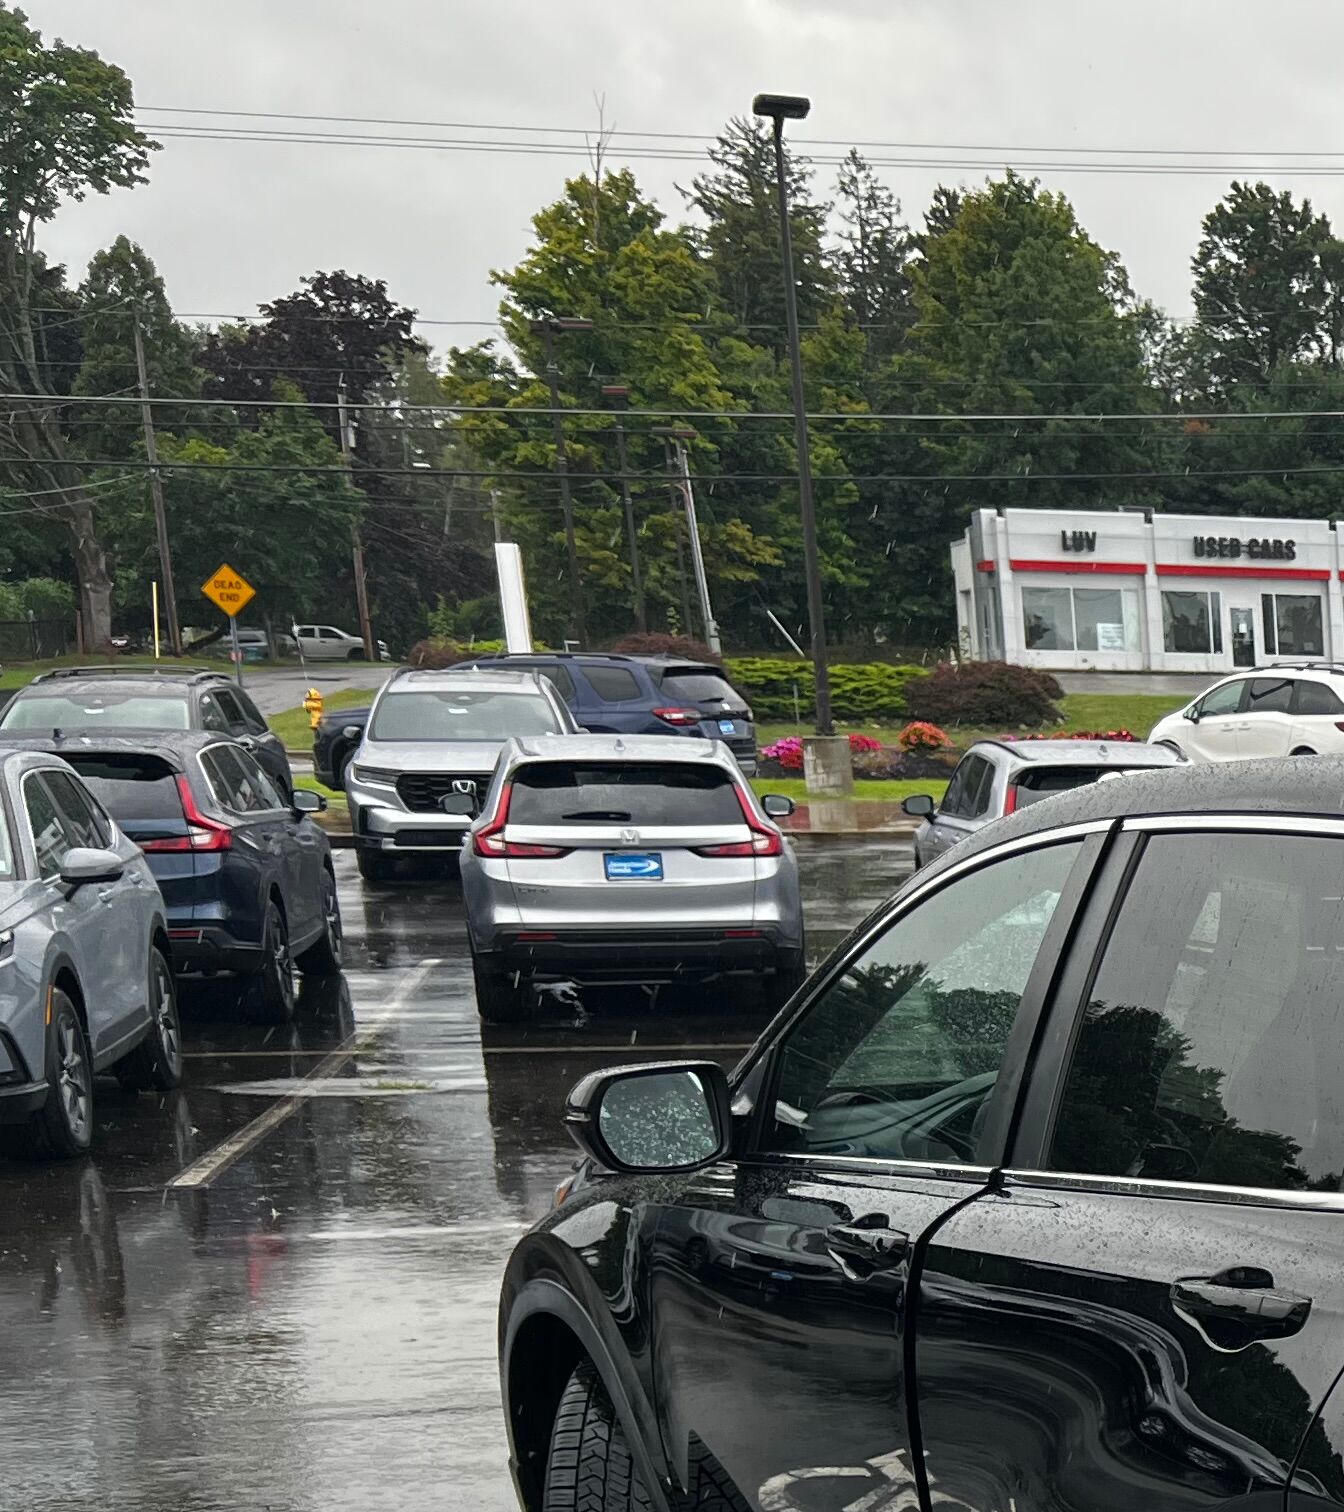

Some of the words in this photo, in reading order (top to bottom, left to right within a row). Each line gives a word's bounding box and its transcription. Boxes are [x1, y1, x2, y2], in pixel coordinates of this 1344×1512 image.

[1061, 530, 1097, 552] LUV
[1193, 536, 1242, 558] USED
[1249, 538, 1297, 561] CARS
[213, 580, 242, 590] DEAD
[220, 592, 240, 602] END
